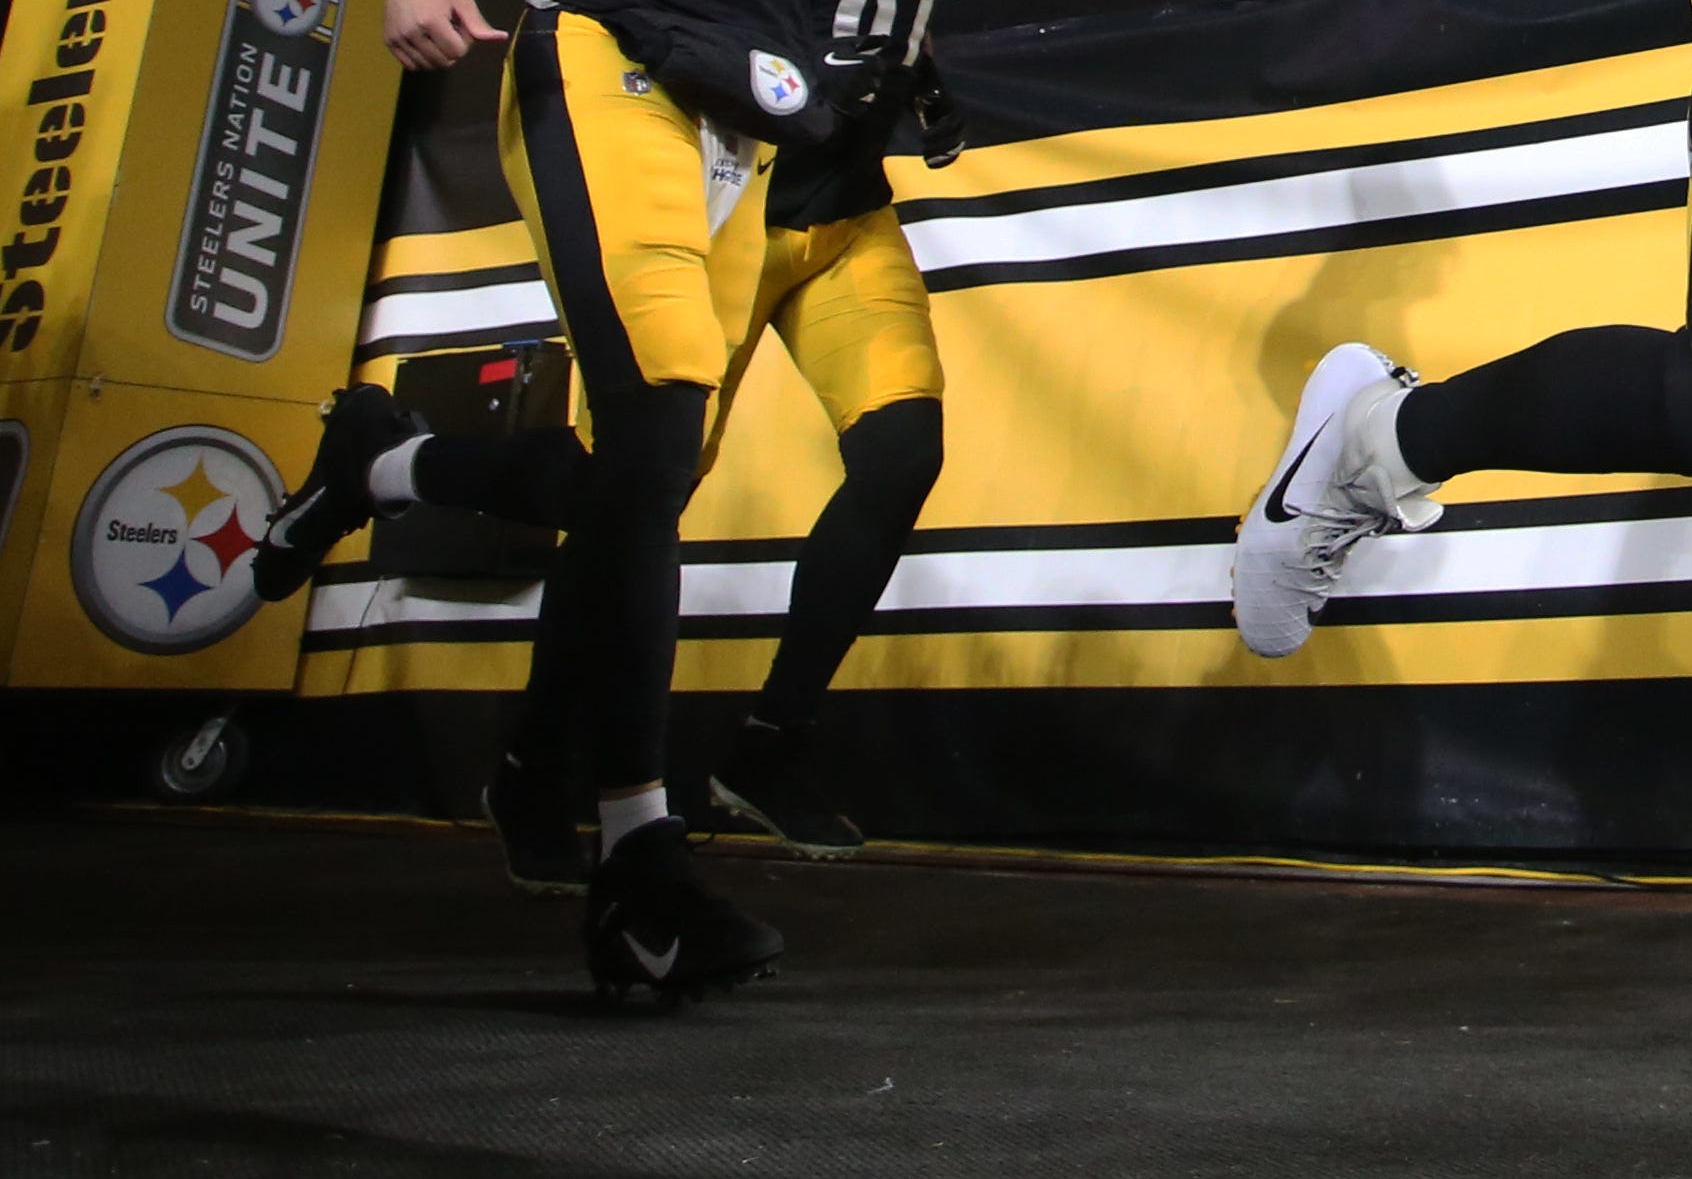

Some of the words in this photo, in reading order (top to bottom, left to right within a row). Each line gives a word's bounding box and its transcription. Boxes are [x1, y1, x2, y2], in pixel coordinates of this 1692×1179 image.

[190, 160, 234, 315] STEELERS
[225, 41, 259, 153] NATION
[212, 52, 312, 331] UNITE
[106, 520, 178, 545] Steelers
